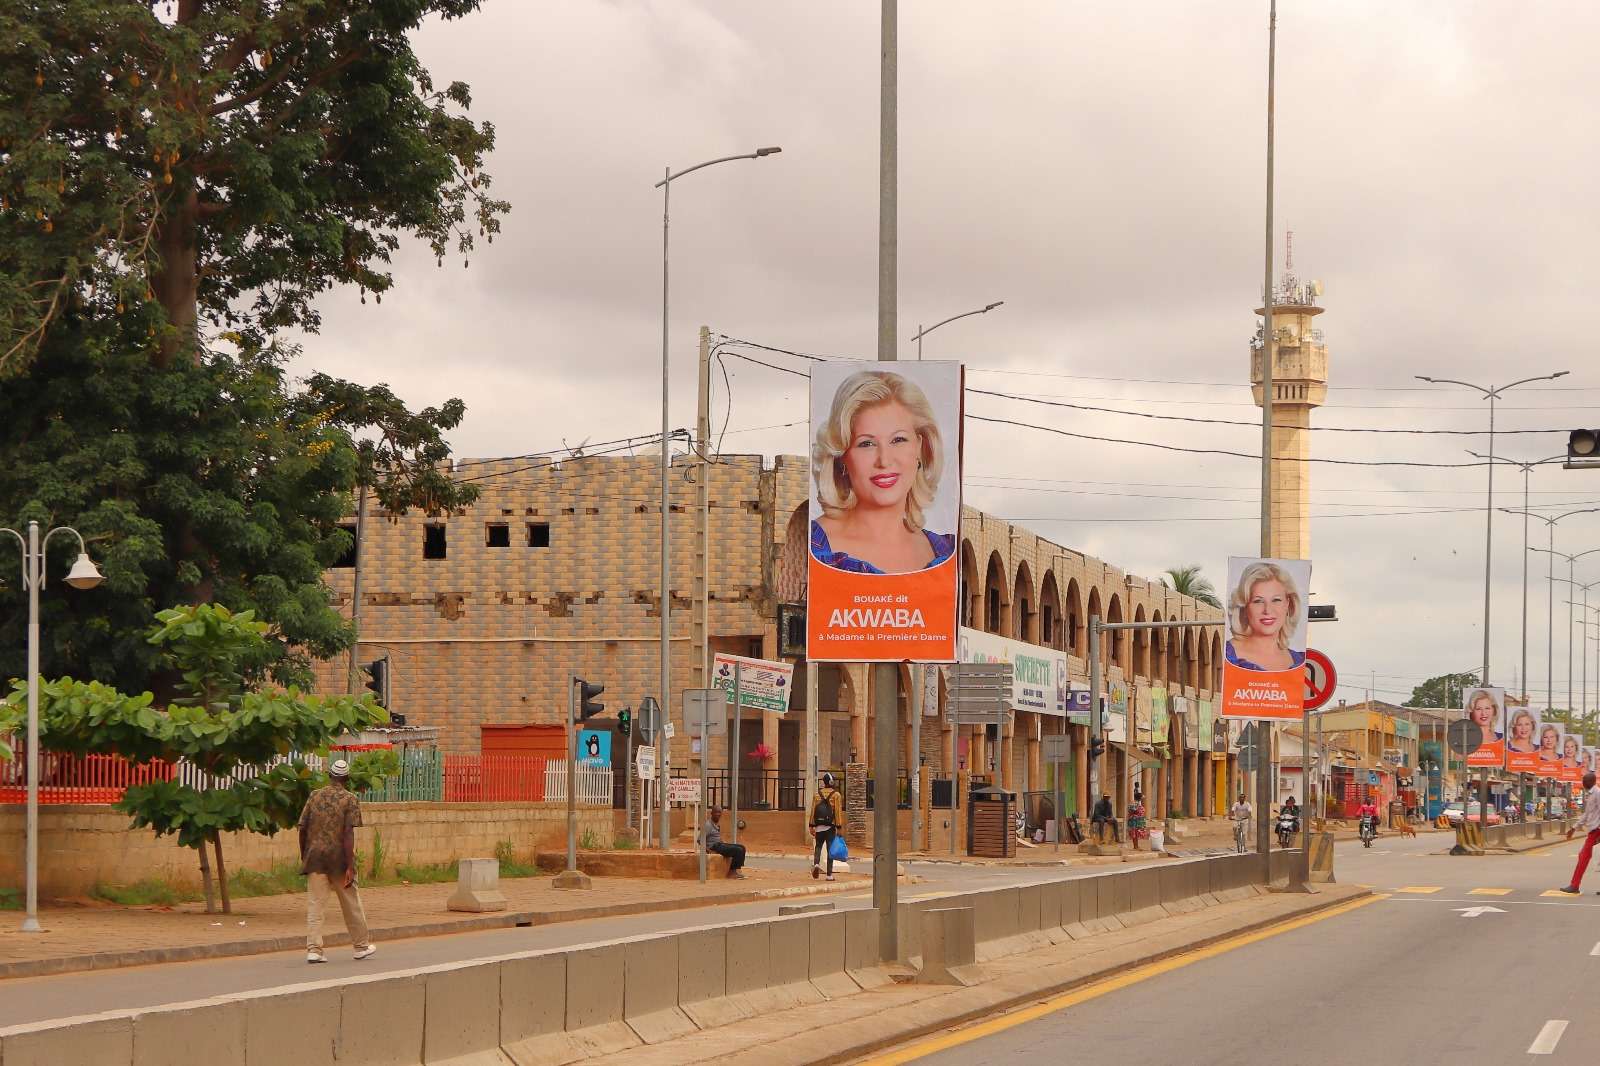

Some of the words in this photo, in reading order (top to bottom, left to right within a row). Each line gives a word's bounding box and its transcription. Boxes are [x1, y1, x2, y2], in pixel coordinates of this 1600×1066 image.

[854, 594, 893, 603] BOUAKÉ
[895, 595, 908, 603] dit
[828, 608, 926, 628] AKWABA
[818, 633, 824, 641] à
[826, 633, 865, 641] Madame
[867, 633, 875, 641] la
[877, 633, 918, 641] Première
[1233, 688, 1288, 701] AKWABA
